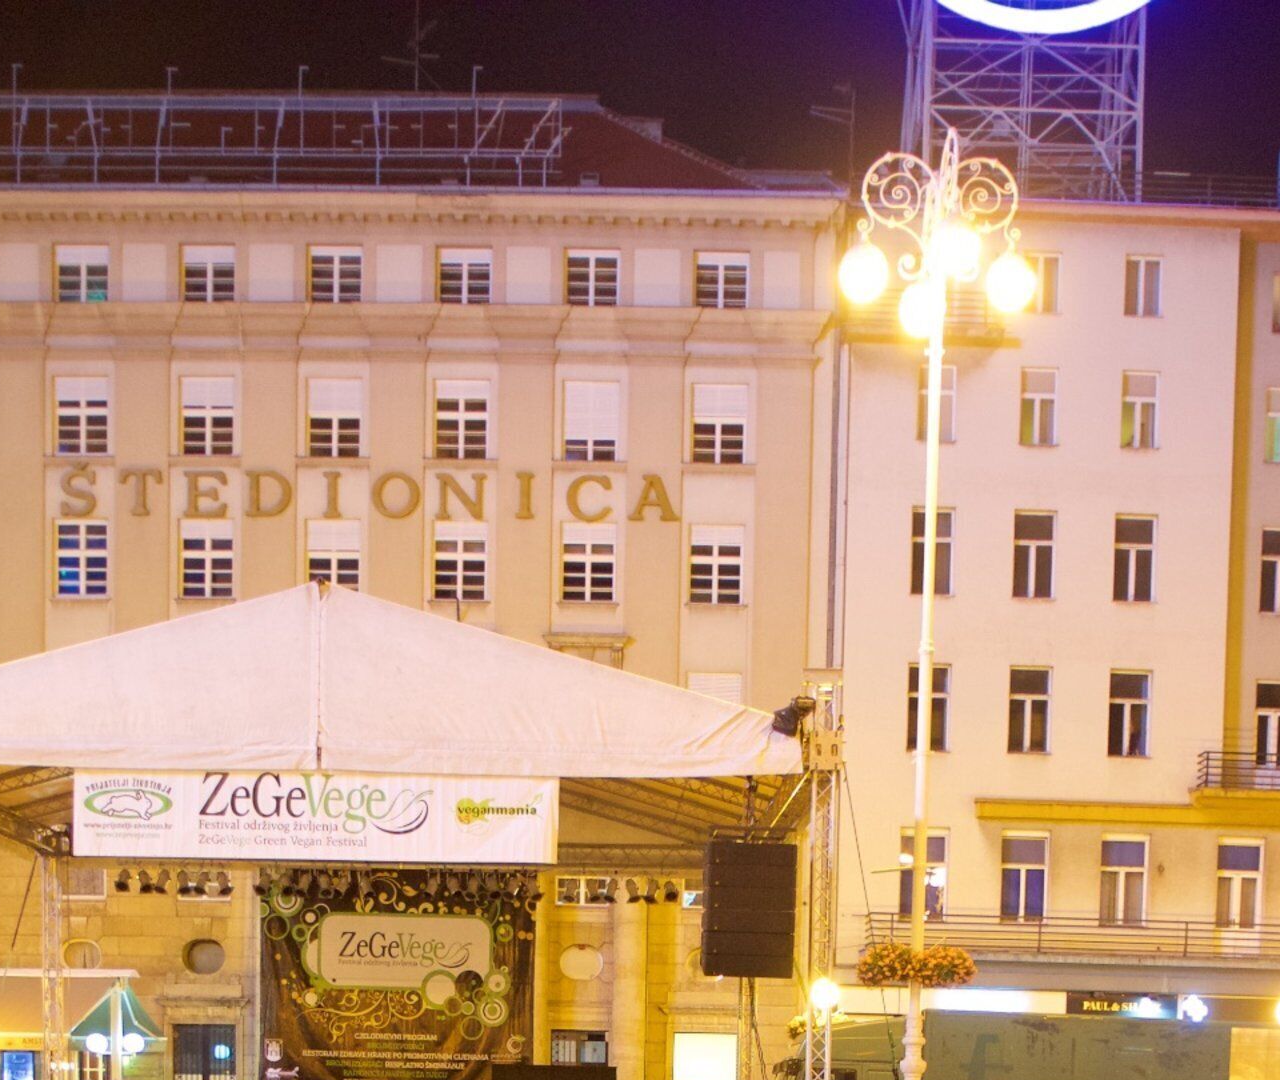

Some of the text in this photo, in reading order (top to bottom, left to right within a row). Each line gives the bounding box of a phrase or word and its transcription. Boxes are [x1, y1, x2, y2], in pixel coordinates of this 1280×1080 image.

[58, 462, 681, 522] ŠTEDIONICA
[199, 771, 389, 834] ZeGeVege
[457, 804, 538, 816] veganmania
[199, 819, 339, 834] Festival održivog življenja
[254, 836, 287, 847] Green
[291, 837, 323, 849] Vegan
[326, 837, 367, 848] Festival
[338, 931, 446, 968] ZeGeVege
[1083, 1001, 1111, 1011] PAUL
